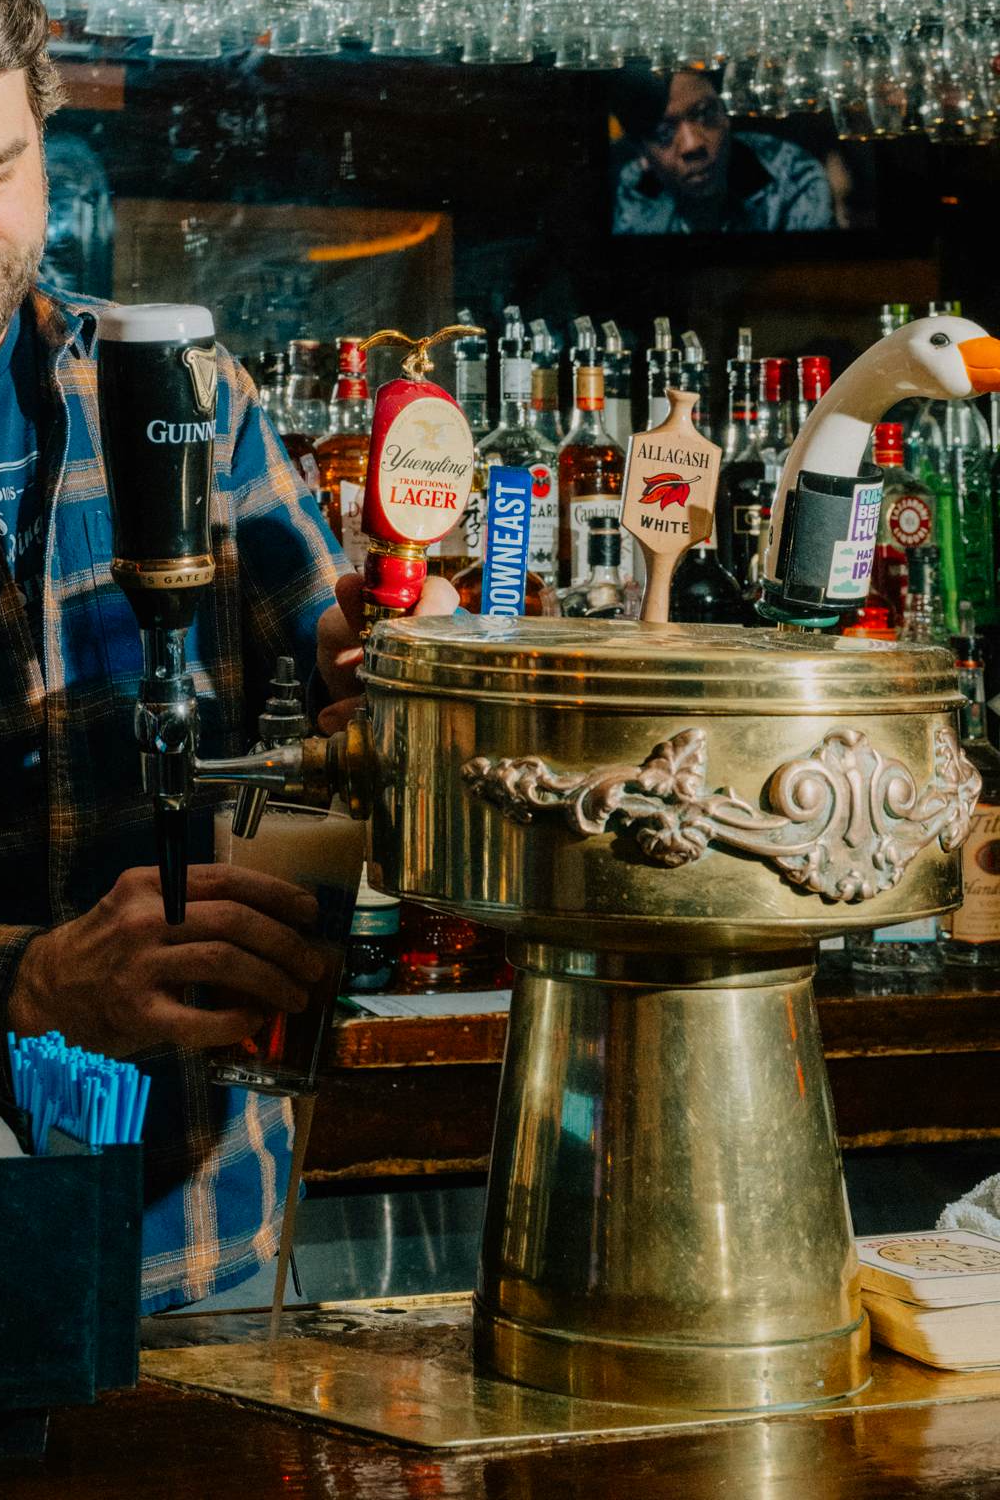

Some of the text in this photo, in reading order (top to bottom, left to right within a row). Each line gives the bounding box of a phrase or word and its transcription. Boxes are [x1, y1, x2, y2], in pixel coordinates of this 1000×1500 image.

[381, 444, 472, 480] Yuengling
[637, 442, 710, 468] ALLAGASH
[399, 477, 454, 490] TRADITIONAL
[389, 485, 457, 510] LAGER
[640, 514, 690, 534] WHITE
[489, 481, 526, 617] DOWNEAST
[856, 548, 874, 560] HAZ
[163, 573, 200, 584] GATE
